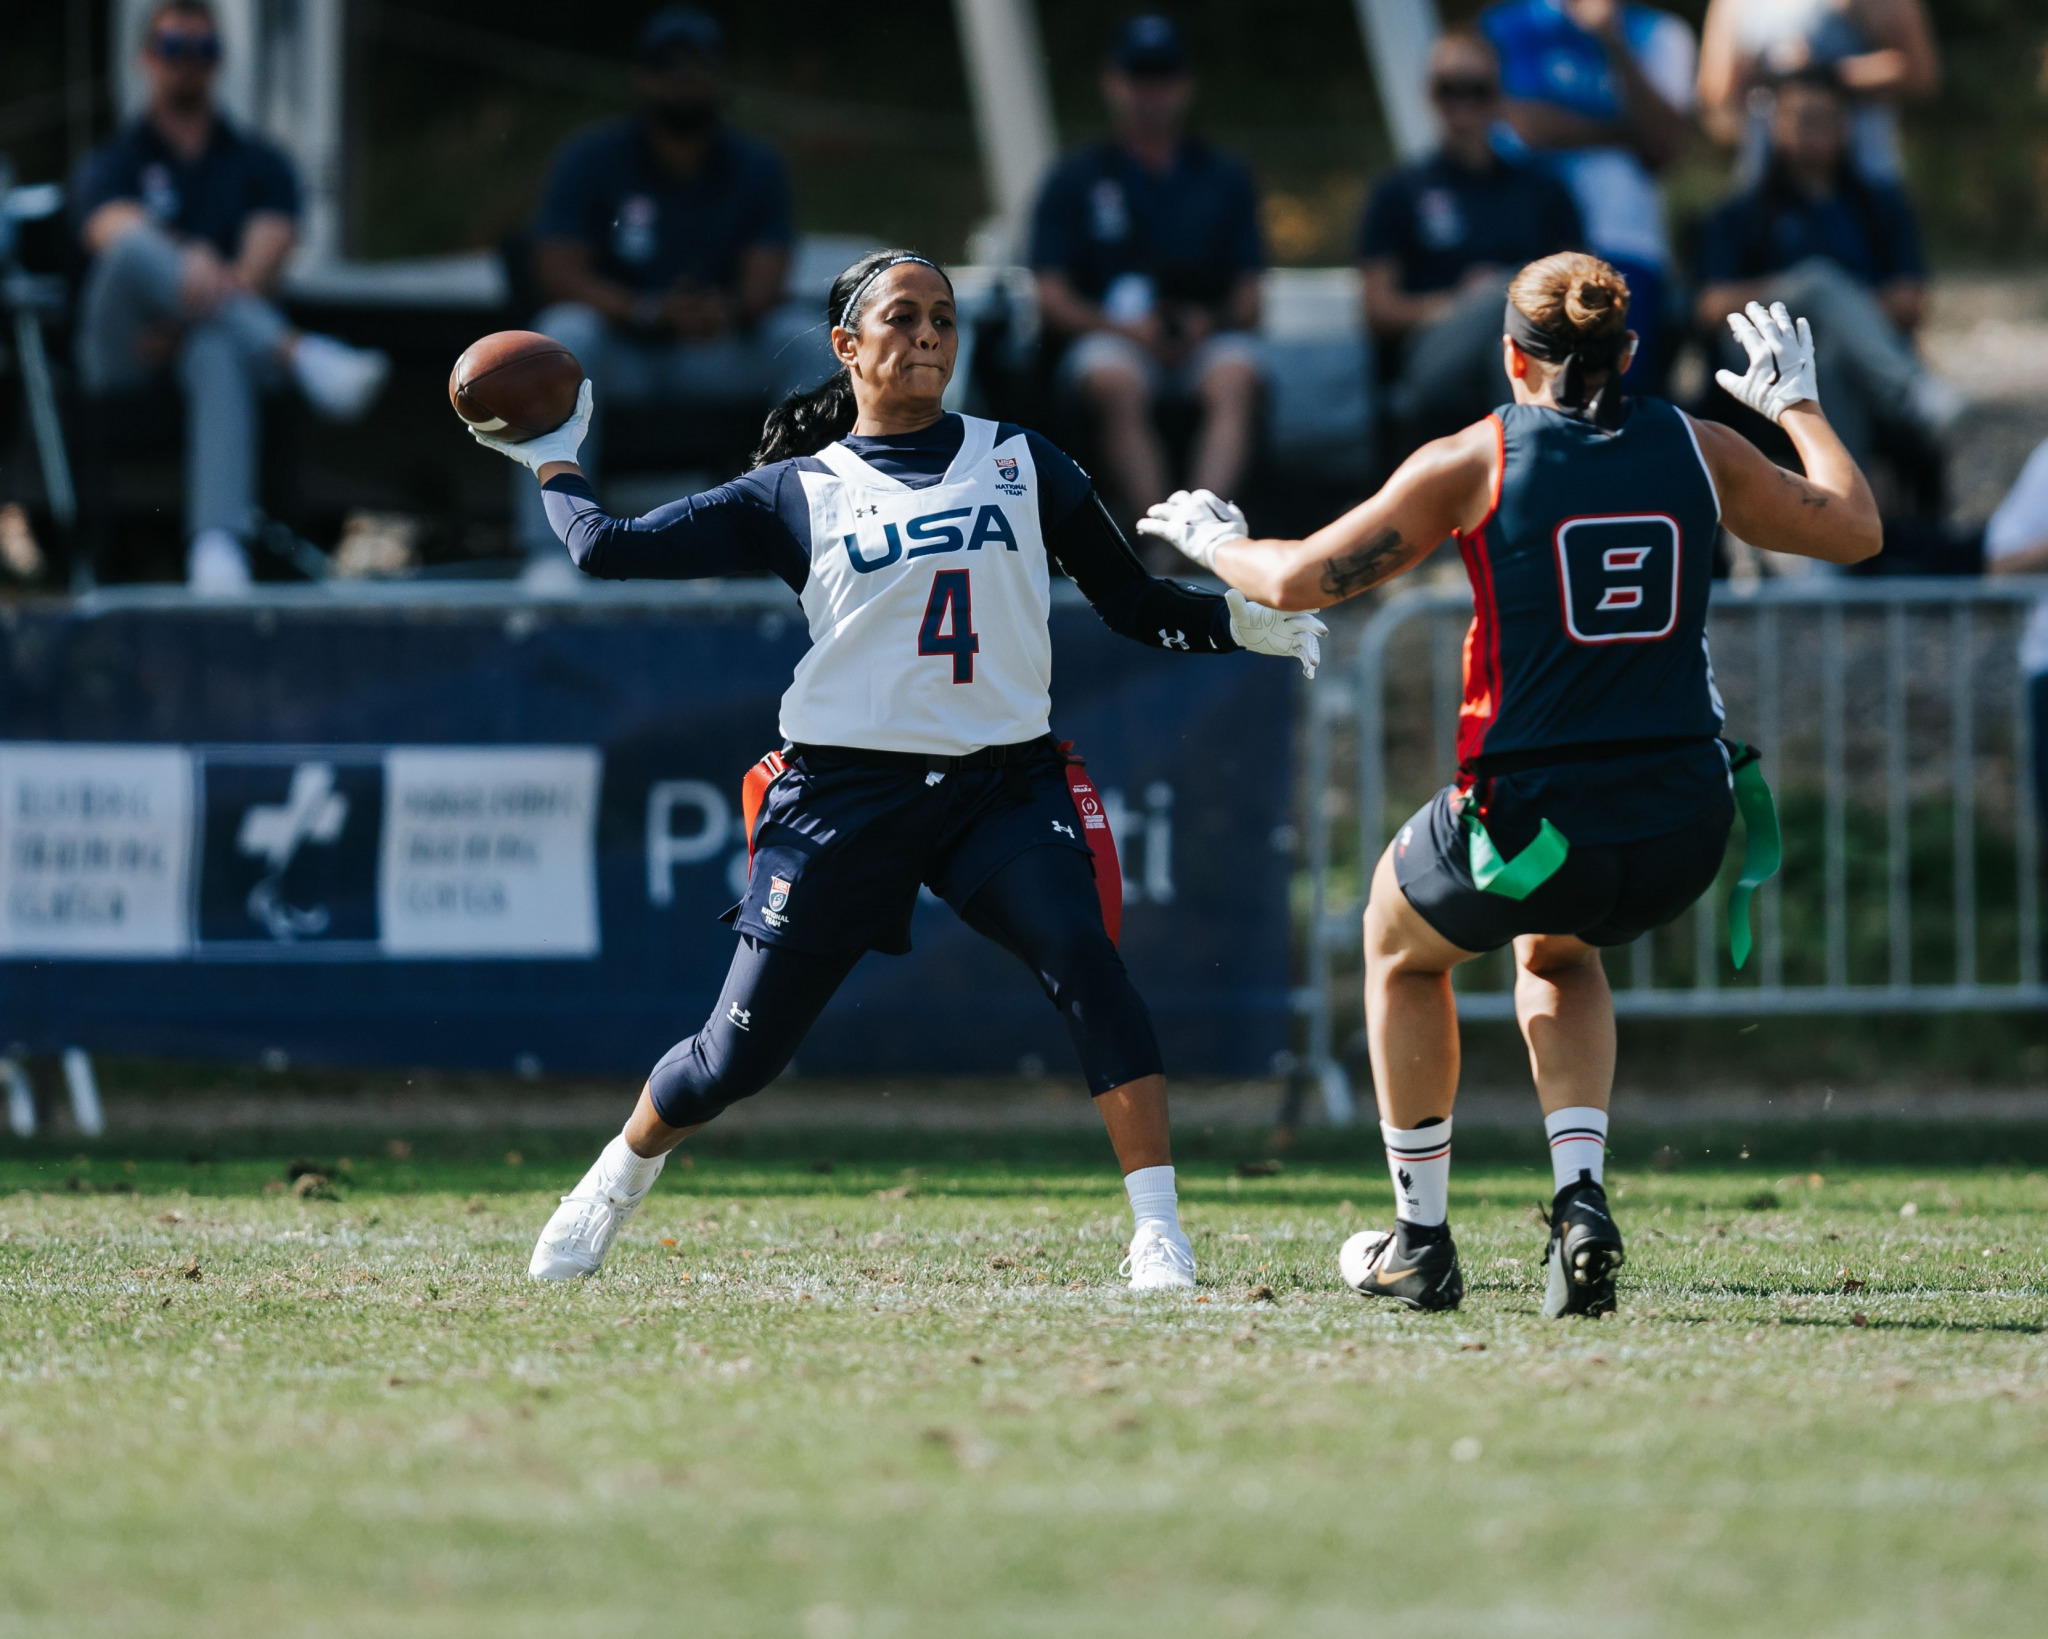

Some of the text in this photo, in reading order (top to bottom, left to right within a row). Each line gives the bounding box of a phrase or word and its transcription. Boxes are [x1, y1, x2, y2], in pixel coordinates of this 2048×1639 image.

[995, 483, 1027, 491] NATIONAL
[843, 504, 1019, 574] USA
[1553, 512, 1682, 645] 8
[918, 568, 979, 684] 4
[761, 906, 789, 922] NATIONAL
[765, 916, 781, 927] TEAM
